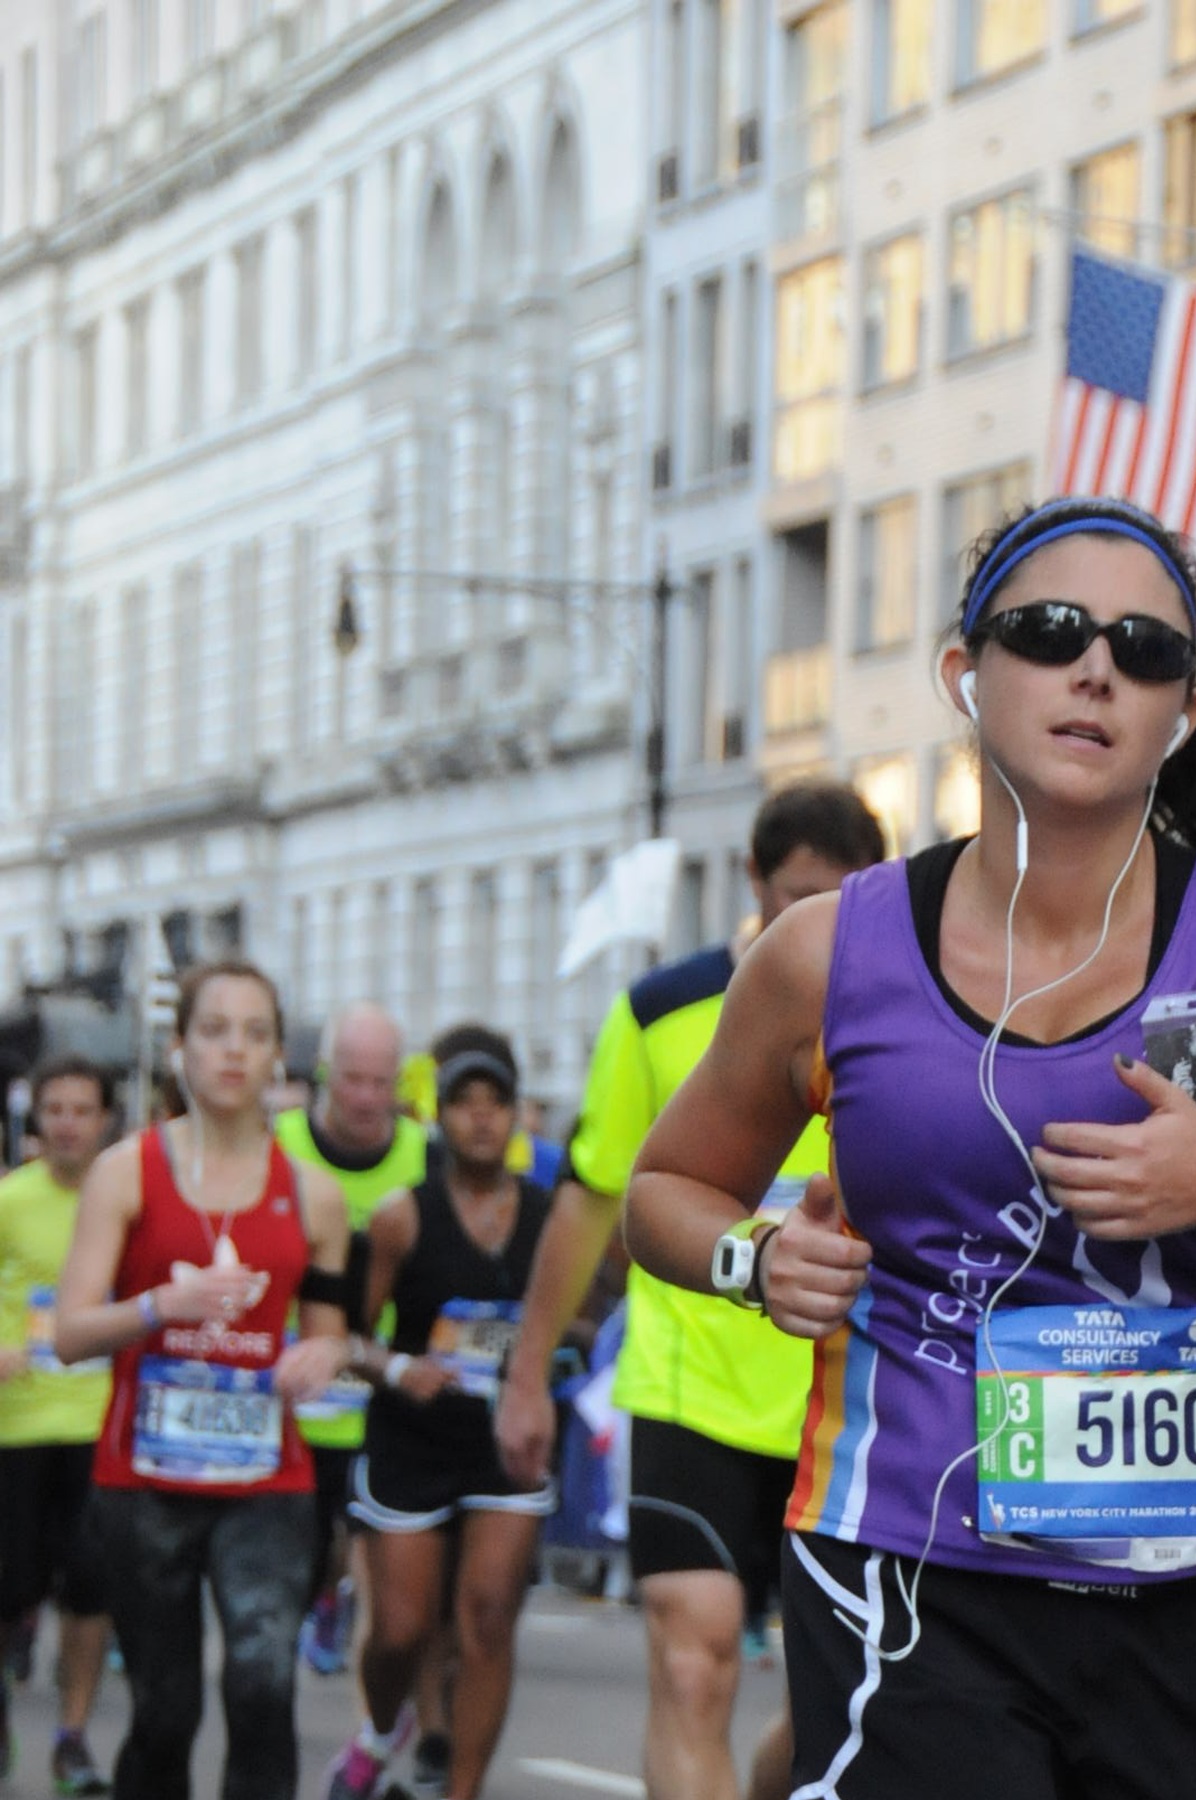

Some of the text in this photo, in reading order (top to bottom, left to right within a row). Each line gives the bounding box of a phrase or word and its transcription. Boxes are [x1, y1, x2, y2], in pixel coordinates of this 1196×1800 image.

[1074, 1310, 1125, 1327] TATA
[1038, 1329, 1161, 1347] CONSULTANCY
[1062, 1349, 1139, 1365] SERVICES
[1008, 1382, 1030, 1424] 3
[1009, 1432, 1035, 1478] C
[1010, 1506, 1038, 1519] TCS
[1041, 1507, 1068, 1518] NEW
[1069, 1507, 1100, 1518] YORK
[1101, 1507, 1127, 1518] CITY
[1129, 1506, 1187, 1517] MARATHON
